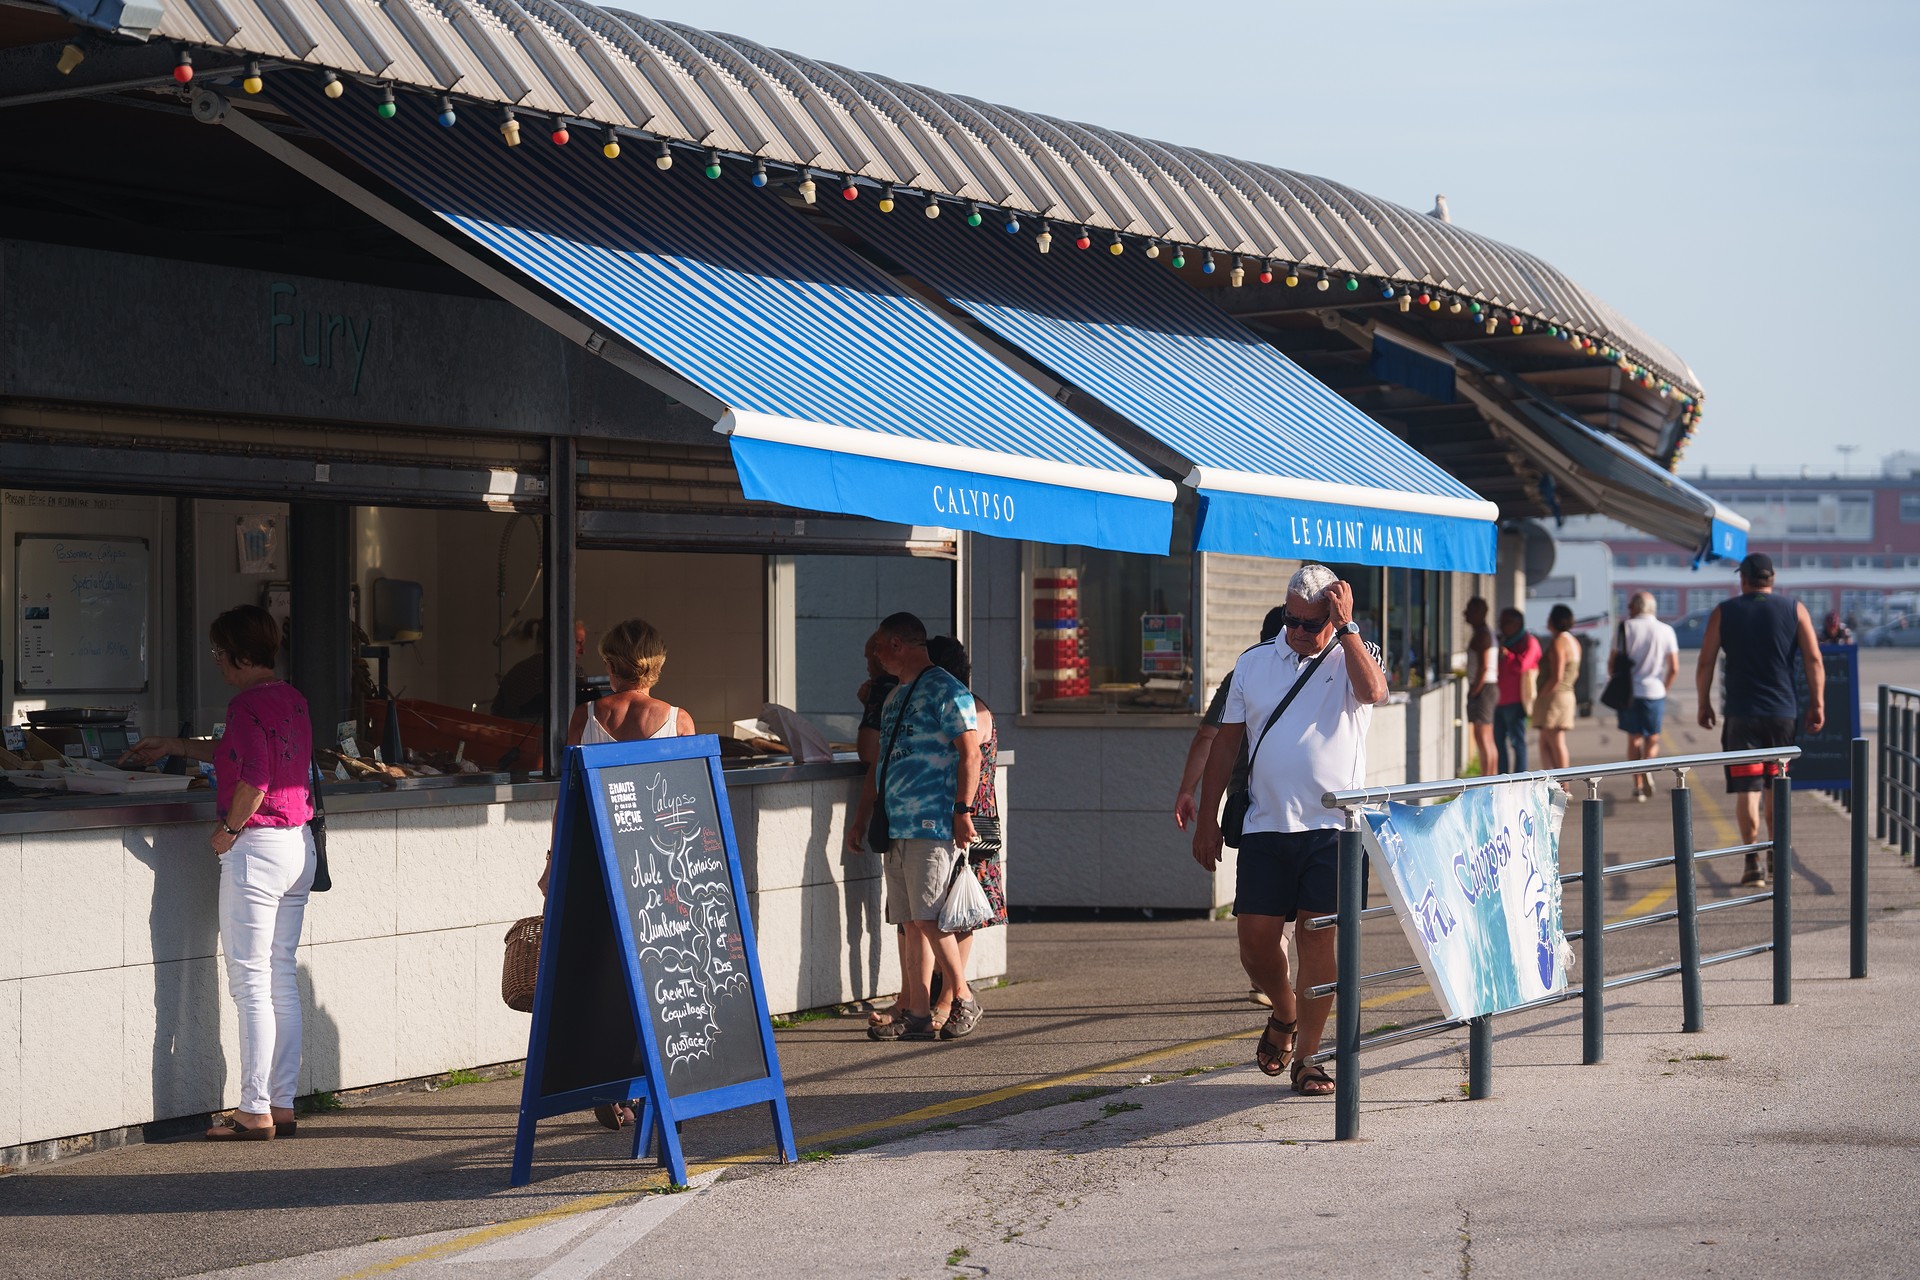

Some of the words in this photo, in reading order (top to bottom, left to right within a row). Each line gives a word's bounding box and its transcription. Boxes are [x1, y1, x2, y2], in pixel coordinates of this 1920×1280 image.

[270, 282, 372, 396] Fury
[932, 484, 1015, 523] CALYPSO
[1291, 515, 1313, 546] LE
[1317, 519, 1363, 551] SAINT
[1370, 525, 1424, 556] MARIN
[1452, 824, 1512, 908] Calypso
[661, 1003, 709, 1027] Coquillage
